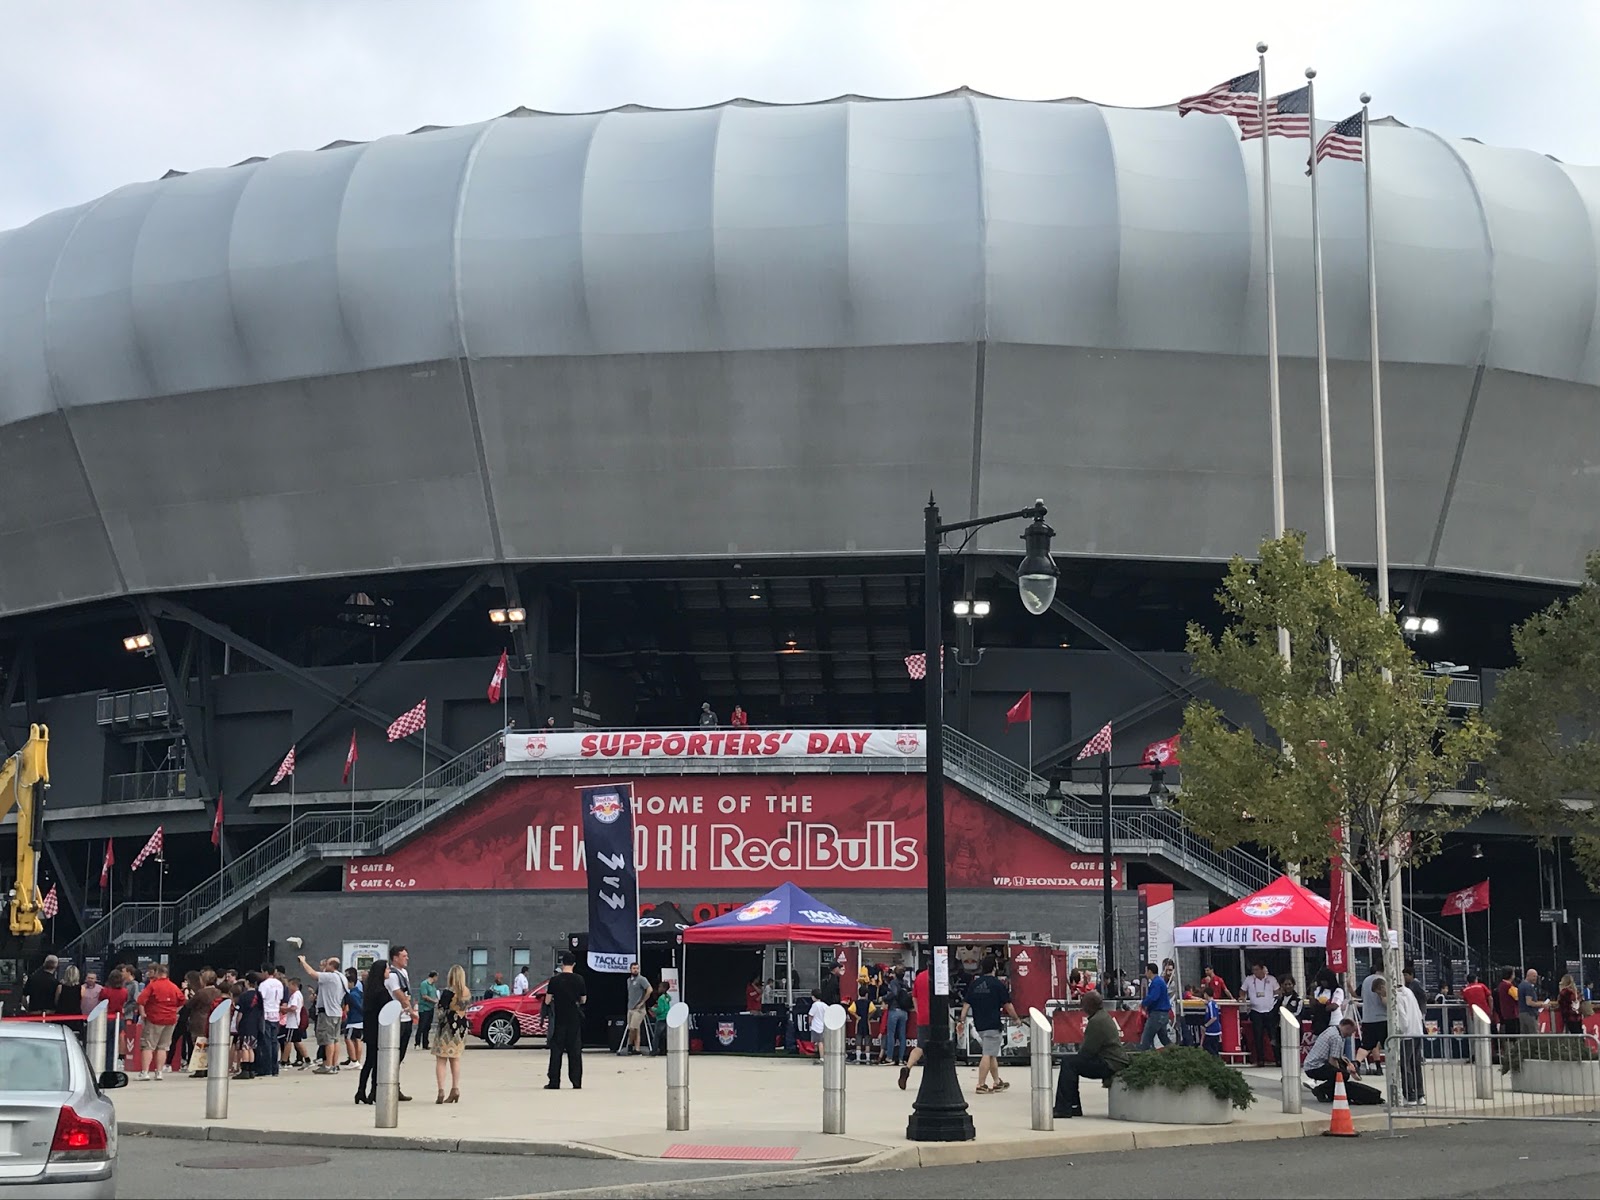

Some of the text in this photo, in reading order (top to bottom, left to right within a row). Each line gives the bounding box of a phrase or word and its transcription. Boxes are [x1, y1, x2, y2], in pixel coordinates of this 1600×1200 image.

[580, 732, 793, 757] SUPPORTERS'
[806, 732, 873, 755] DAY
[629, 795, 813, 814] HOME OF THE
[634, 824, 697, 871] ORK
[361, 863, 383, 872] GATE
[1069, 862, 1095, 870] GATE
[360, 879, 382, 887] GATE
[408, 879, 416, 887] D
[993, 877, 1012, 887] VIP,
[1025, 877, 1078, 886] HONDA
[516, 931, 523, 940] 2
[560, 931, 566, 940] 3
[1192, 928, 1317, 944] NEW YORK Red Bulls
[594, 955, 628, 966] TACKLE
